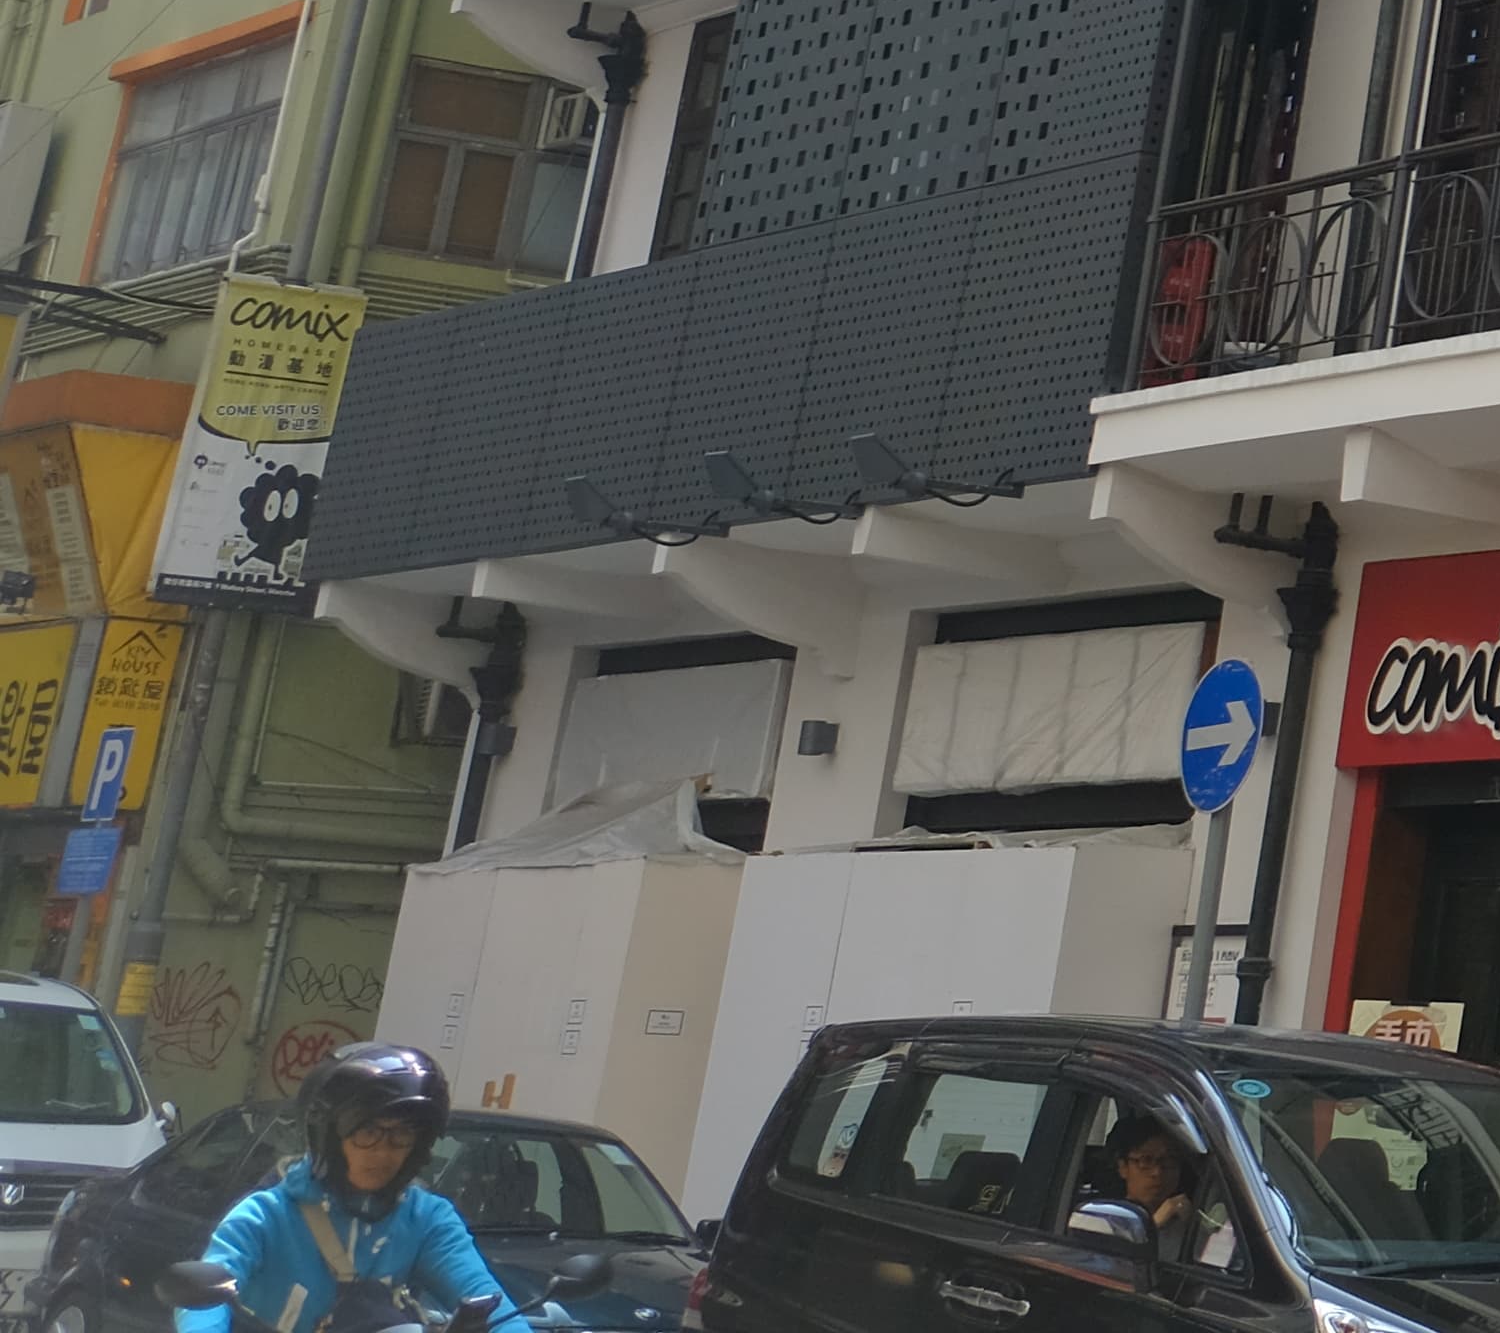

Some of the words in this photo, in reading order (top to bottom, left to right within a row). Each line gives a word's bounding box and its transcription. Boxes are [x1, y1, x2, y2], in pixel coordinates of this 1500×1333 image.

[233, 338, 336, 358] HOMEBASE
[228, 350, 334, 378] 動漫基地
[216, 405, 257, 416] COME
[262, 405, 297, 416] VISIT
[112, 658, 161, 676] HOUSE
[90, 739, 124, 810] P
